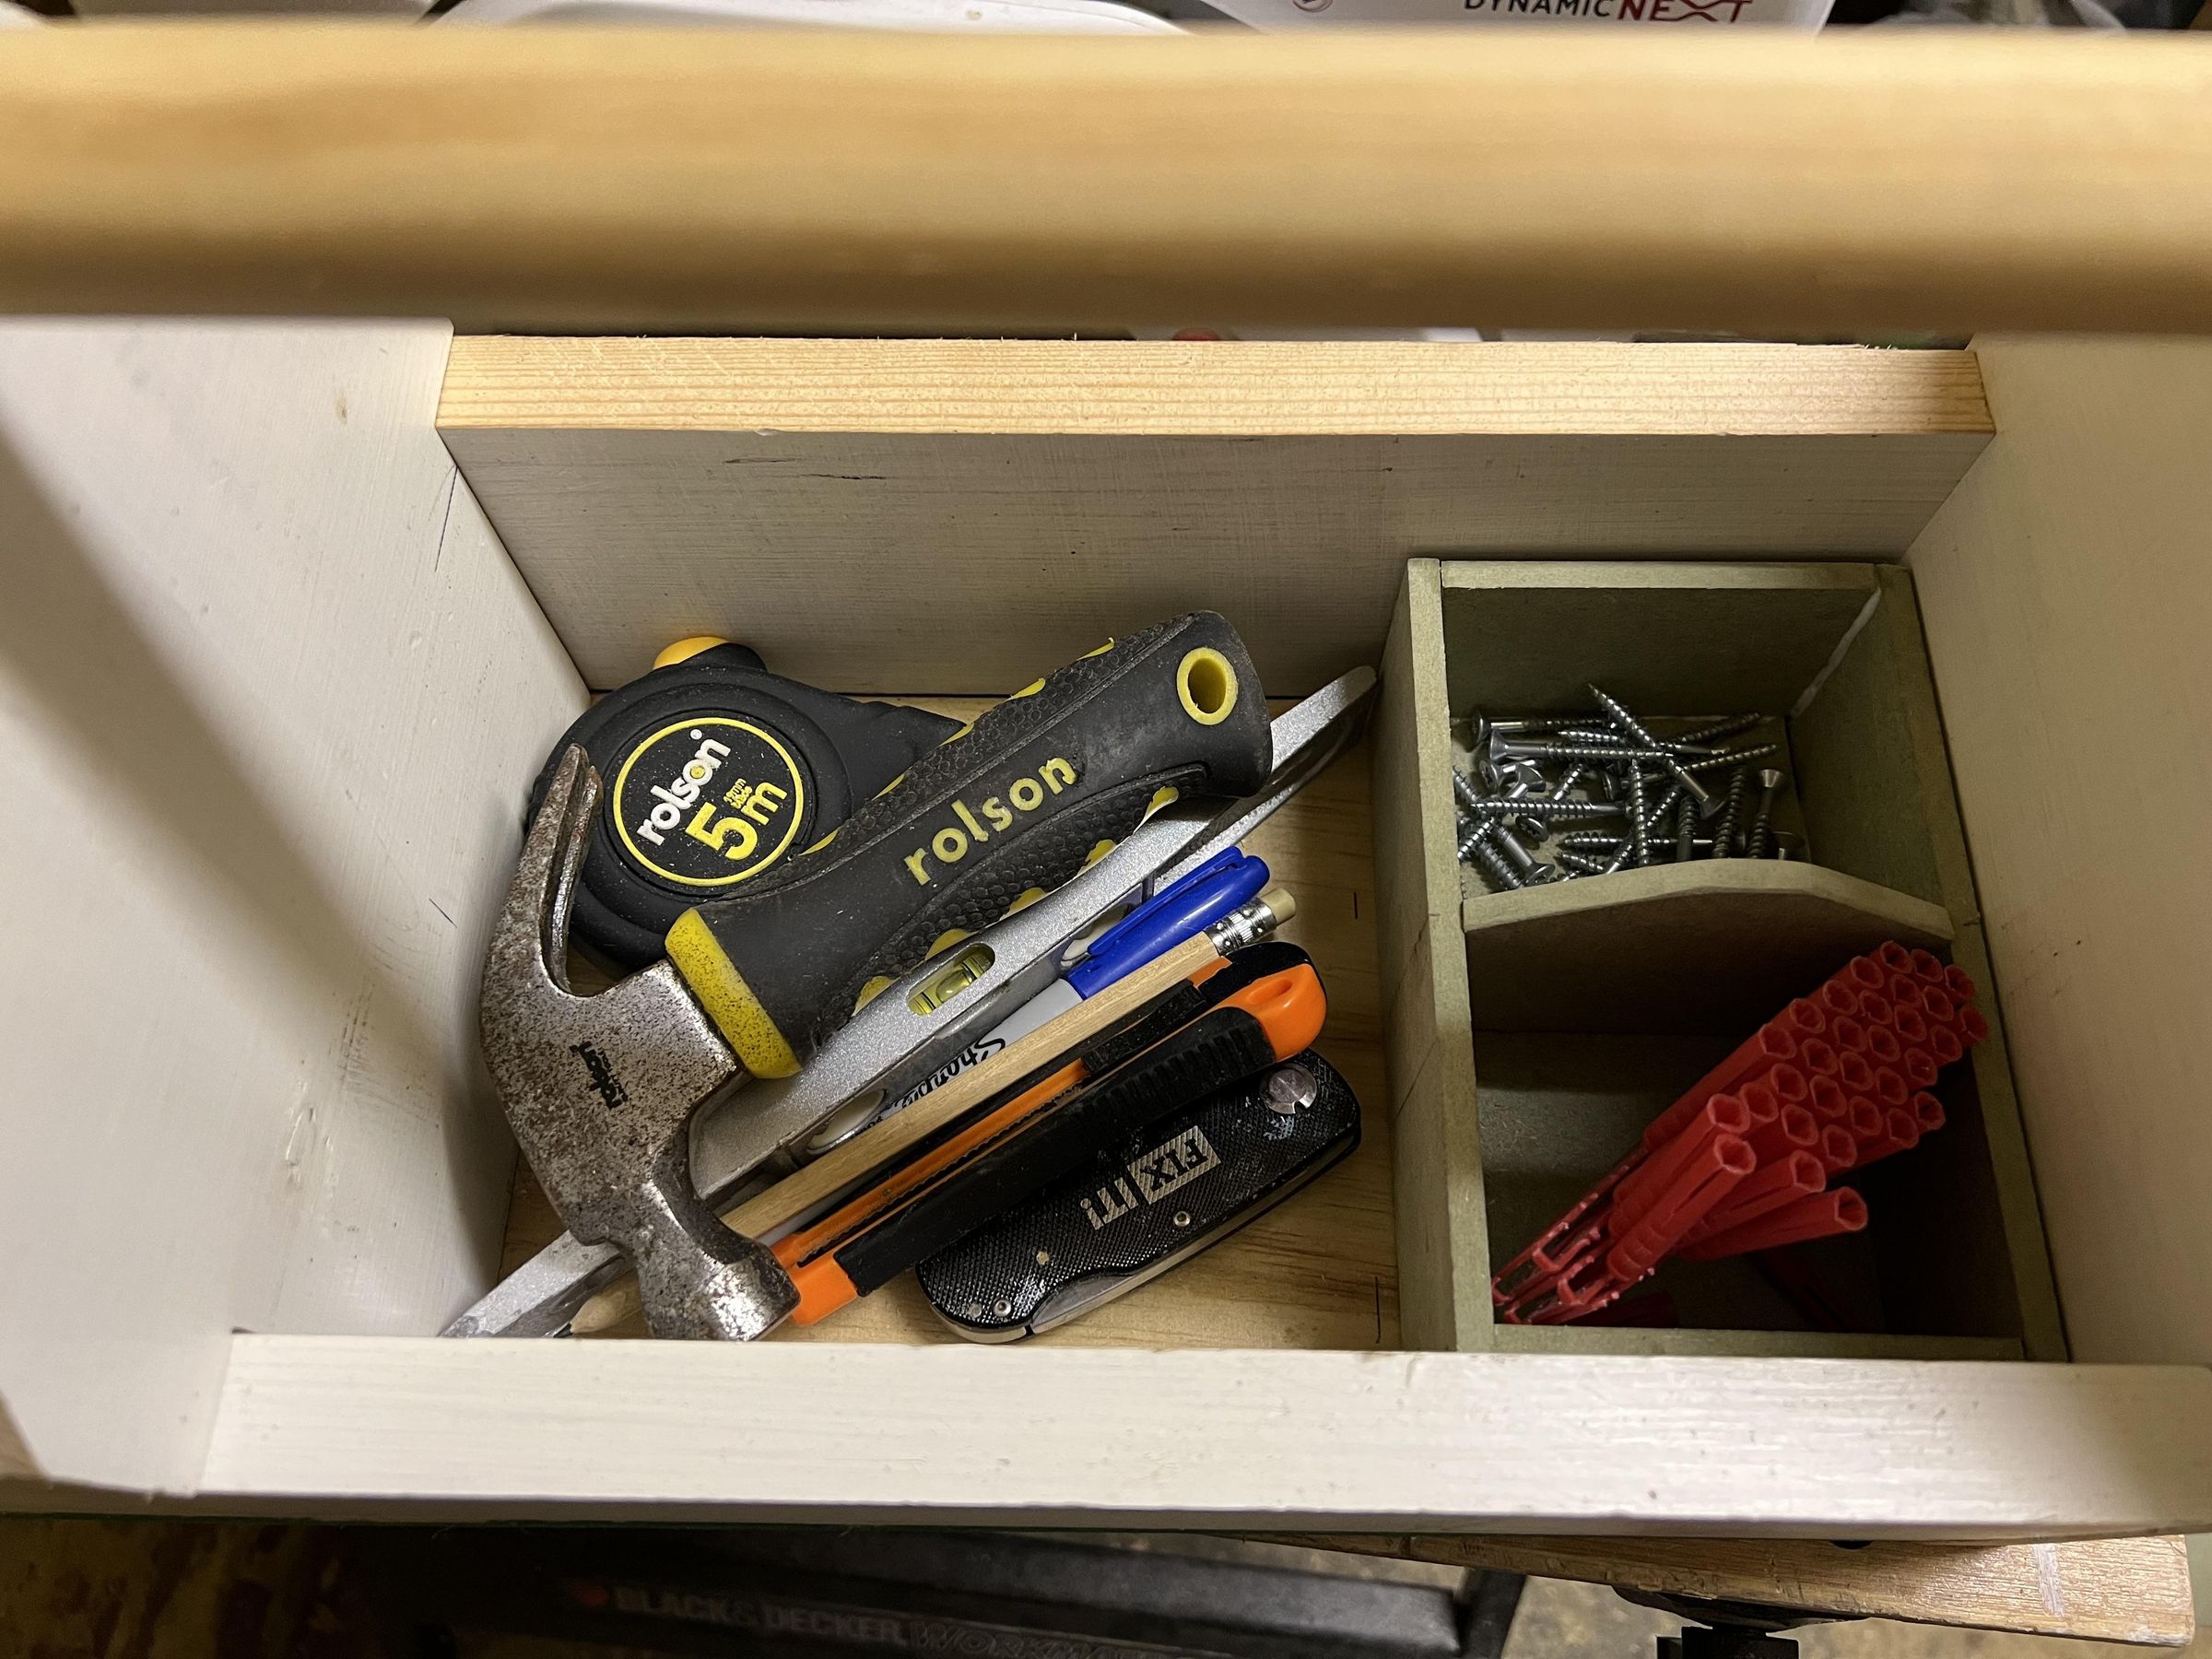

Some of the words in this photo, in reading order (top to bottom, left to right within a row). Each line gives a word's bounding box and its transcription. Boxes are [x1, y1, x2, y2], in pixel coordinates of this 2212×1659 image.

[636, 738, 731, 846] rolson
[685, 781, 788, 861] 5m
[903, 757, 1078, 886] rolson
[1139, 1137, 1208, 1192] FIX
[1079, 1176, 1139, 1230] IT!
[614, 1584, 730, 1625] BLACK
[760, 1603, 908, 1647] DECKER
